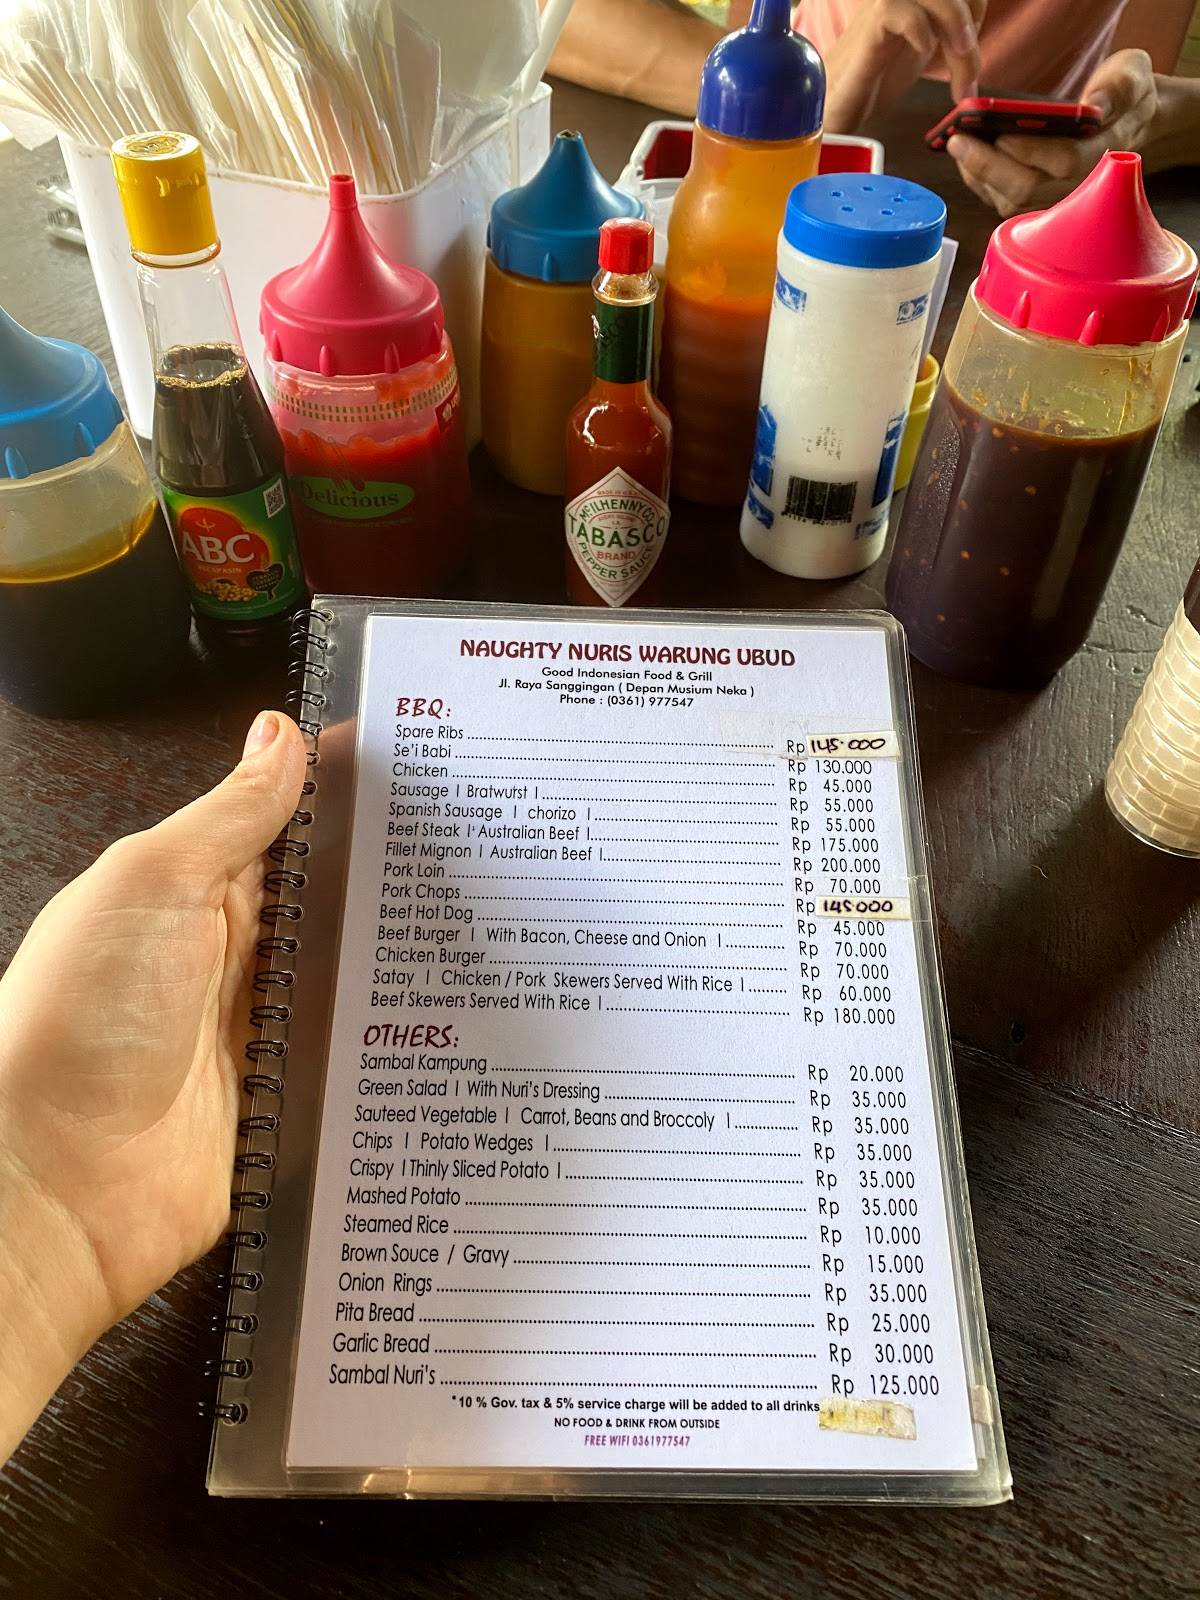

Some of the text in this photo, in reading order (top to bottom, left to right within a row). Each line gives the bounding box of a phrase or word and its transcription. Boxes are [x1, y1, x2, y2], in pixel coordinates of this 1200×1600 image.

[302, 484, 400, 508] Delicious
[568, 512, 666, 549] TABASCO
[182, 531, 255, 564] ABC
[579, 542, 617, 580] PEPPER
[597, 551, 636, 561] BRAND
[460, 639, 796, 667] NAUGHTY NURIS WARUNG UBUD
[515, 679, 542, 692] Raya
[545, 679, 615, 694] Sanggingan
[625, 682, 664, 695] Depan
[666, 683, 713, 695] Musium
[716, 684, 747, 696] Neka
[541, 666, 713, 682] Good Indonesian Food Grill
[395, 697, 451, 721] BBQ:
[559, 693, 694, 708] Phone (0361) 977547
[395, 723, 464, 741] Spare Ribs
[421, 743, 452, 759] Babi
[815, 759, 872, 775] 130.000
[392, 762, 872, 794] Chicken 45.000
[390, 781, 874, 813] Sausage Bratwurst 55.000
[388, 801, 875, 833] Spanish Sausage chorizo 55.000
[387, 821, 879, 853] Beef Steak Australian Beef 175.000
[385, 841, 881, 874] Fillet Mignon Australian Beef 200.000
[381, 882, 461, 904] Pork Chops
[384, 862, 881, 894] Pork Loin 70.000
[380, 903, 885, 936] Beef Hot Dog 45.000
[377, 925, 887, 958] Beef Burger With Bacon, Cheese Onion 70.000
[375, 946, 889, 980] Chicken Burger 70.000
[373, 968, 891, 1003] Satay Chicken Pork Skewers Served With Rice 60.000
[371, 990, 895, 1025] Beef Skewers Served With Rice 180.000
[363, 1023, 459, 1049] OTHERS:
[360, 1052, 904, 1083] Sambal Kampung 20.000
[358, 1078, 906, 1109] Green Salad With Nuri's Dressing 35.000
[354, 1104, 909, 1135] Sauteed Vegetable Carrot, Beans Broccoly 35.000
[352, 1131, 912, 1162] Chips Potato Wedges 35.000
[350, 1158, 915, 1189] Crispy Thinly Sliced Potato 35.000
[346, 1185, 918, 1217] Mashed Potato 35.000
[343, 1214, 921, 1245] Steamed Rice 10.000
[341, 1243, 924, 1274] Brown Souce Gravy 15.000
[338, 1272, 927, 1304] Onion Rings 35.000
[335, 1301, 930, 1334] Pita Bread 25.000
[332, 1332, 934, 1364] Garlic Bread 30.000
[329, 1363, 939, 1396] Sambal Nuri's 125.000
[490, 1396, 821, 1413] Gov. tax 5% service charge will added all drinks
[554, 1416, 720, 1429] NO FOOD DRINK FROM OUTSIDE
[584, 1434, 691, 1447] FREE WIFI 0361977547
